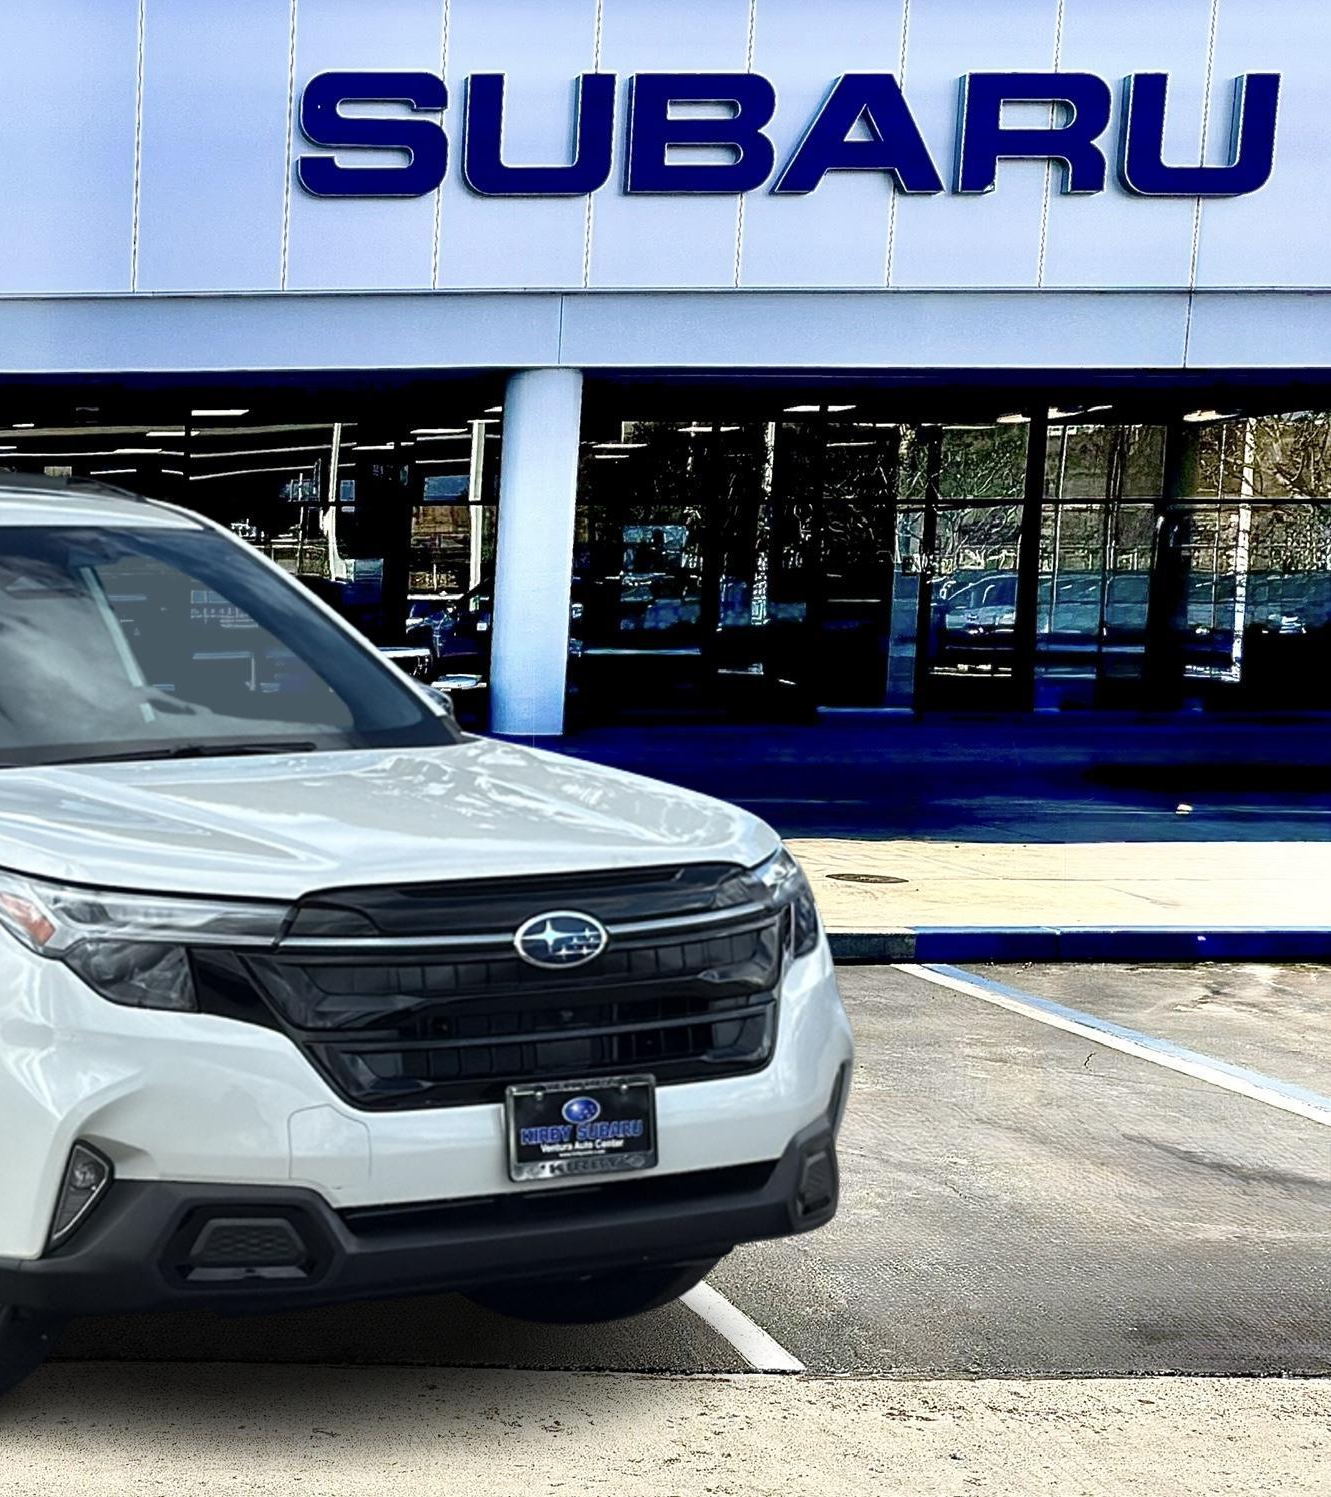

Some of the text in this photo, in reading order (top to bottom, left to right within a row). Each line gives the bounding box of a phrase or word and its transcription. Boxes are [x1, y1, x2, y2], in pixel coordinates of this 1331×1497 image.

[296, 70, 1281, 197] SUBARU
[521, 1119, 644, 1146] KIRBY SUBARU
[540, 1138, 625, 1153] Ventura Auto Center
[549, 1156, 621, 1175] KIRBY
